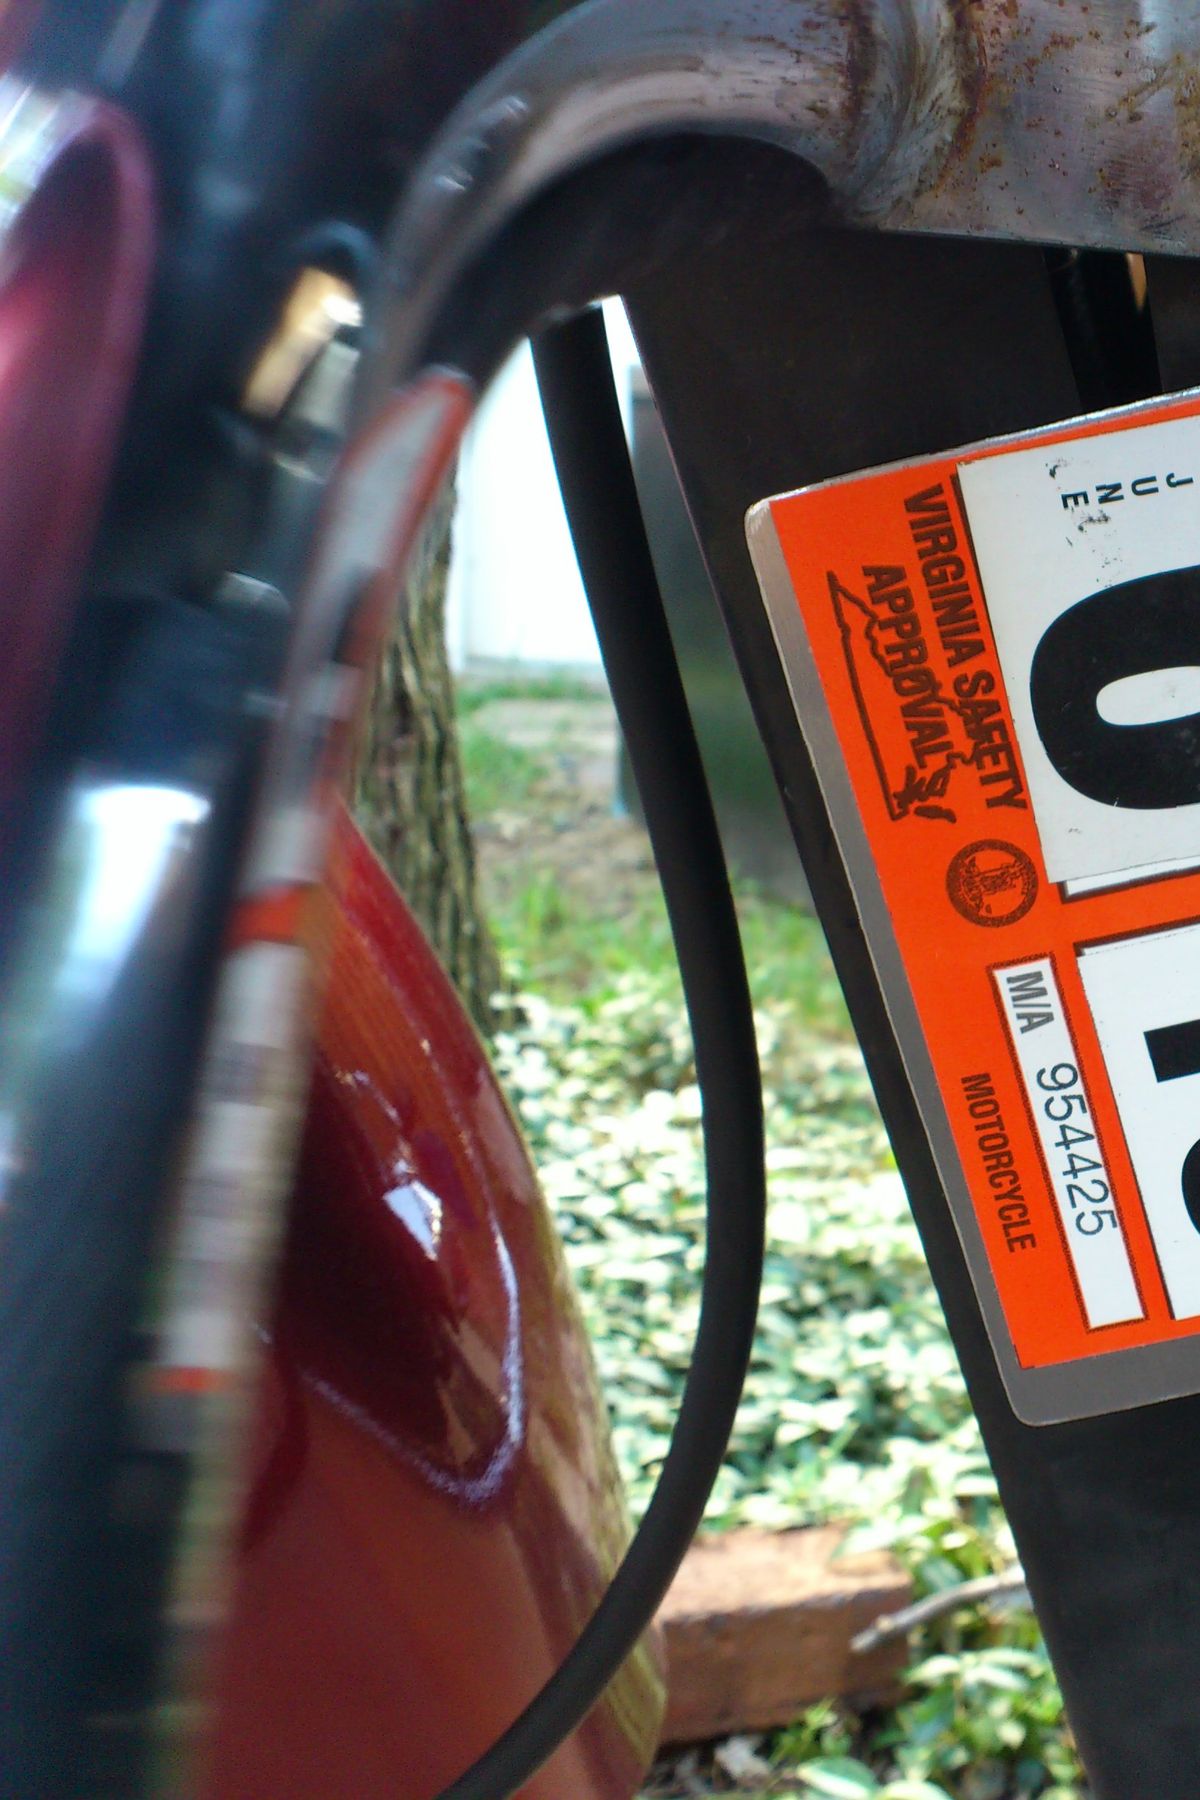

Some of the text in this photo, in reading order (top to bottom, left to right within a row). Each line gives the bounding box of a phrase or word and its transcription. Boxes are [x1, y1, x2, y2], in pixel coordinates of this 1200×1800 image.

[861, 563, 945, 764] APPROVAL
[903, 483, 987, 667] VIRGINIA
[945, 670, 1024, 810] SAFETY
[959, 1073, 1034, 1251] MOTORCYCLE
[1004, 972, 1117, 1237] M/A 954425
